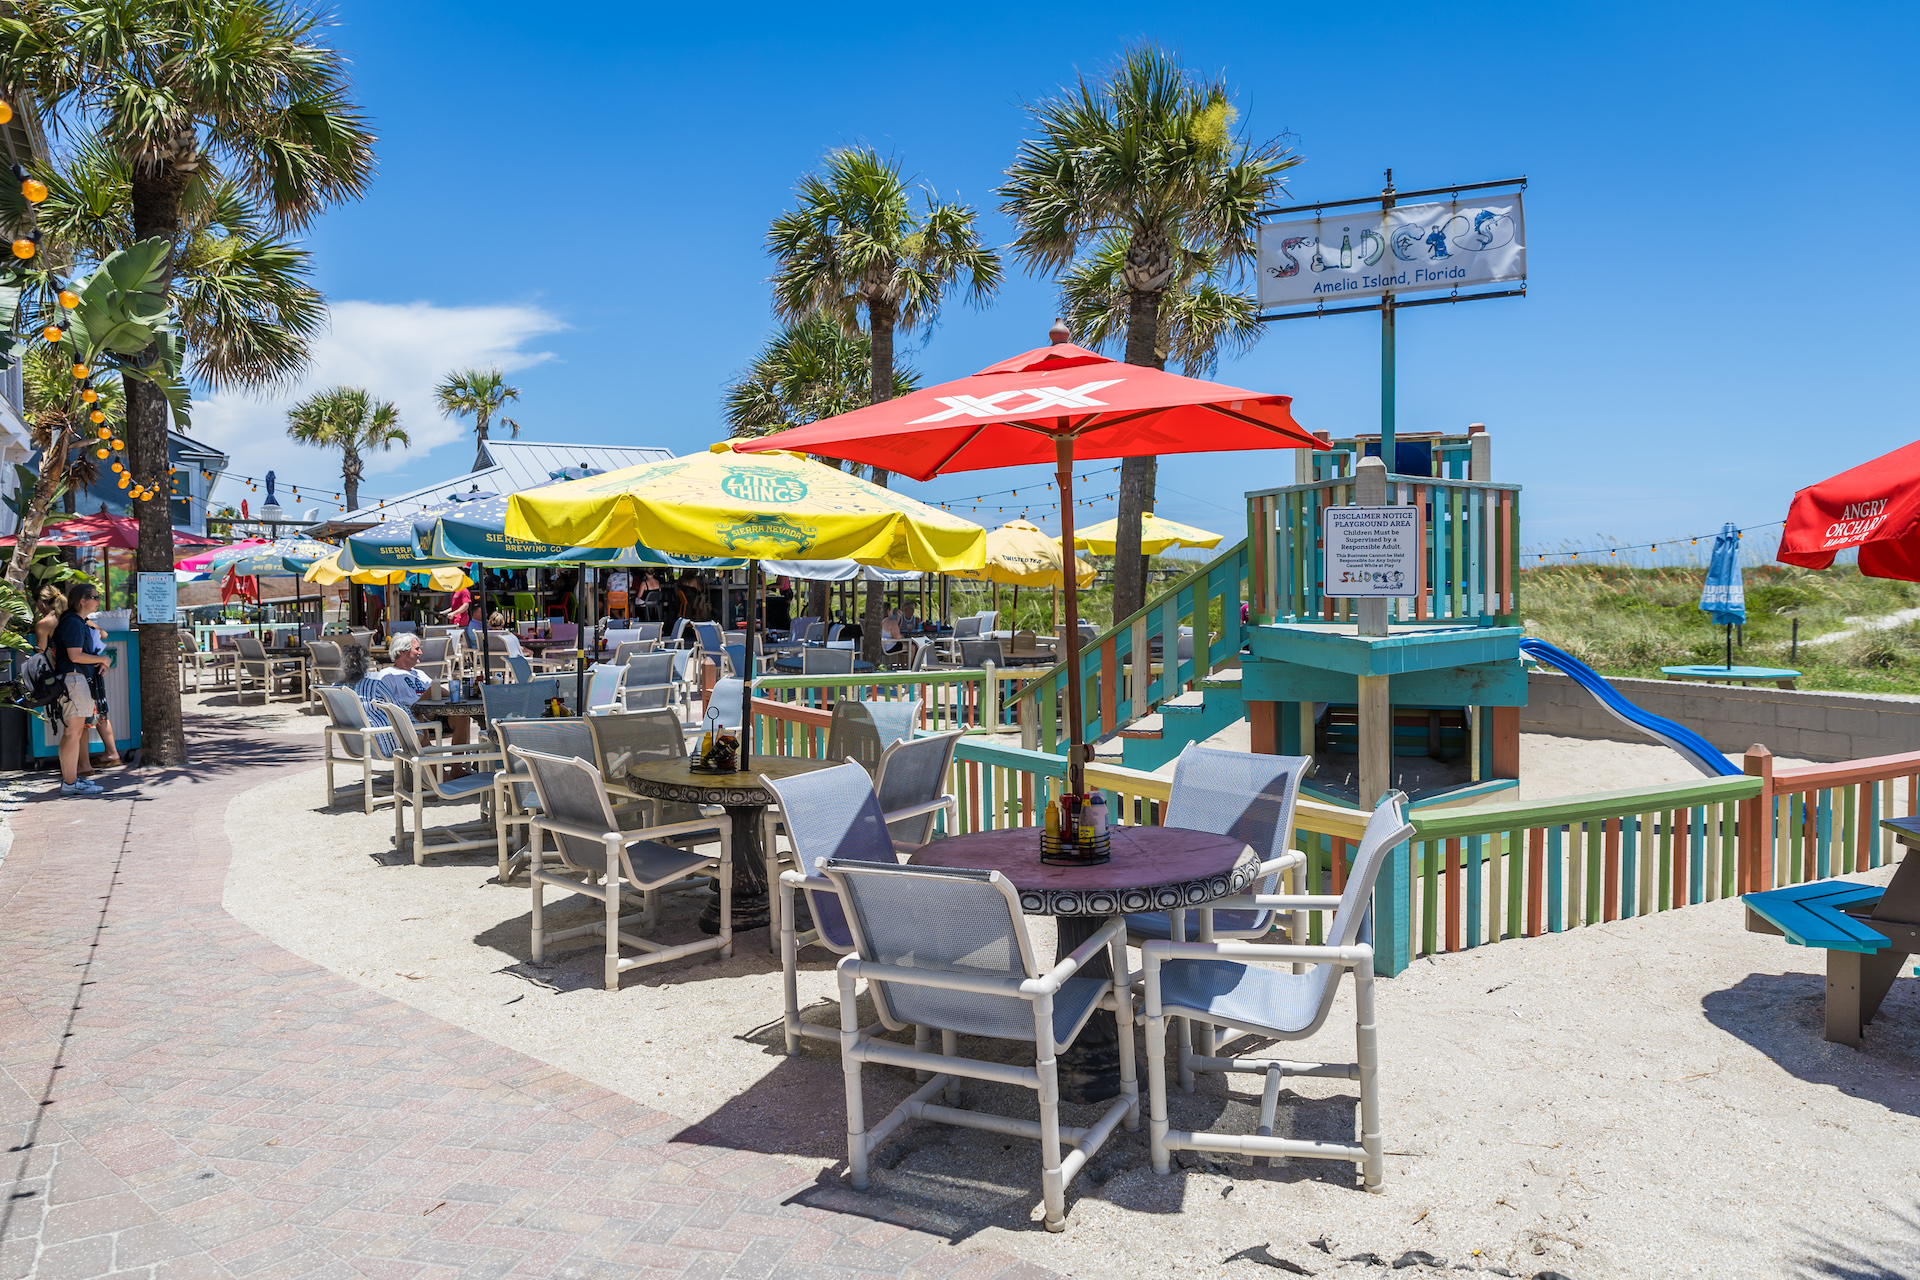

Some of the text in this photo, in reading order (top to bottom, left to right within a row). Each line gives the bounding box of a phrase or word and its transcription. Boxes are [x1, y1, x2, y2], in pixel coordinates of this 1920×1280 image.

[1313, 266, 1466, 294] Amelia Island, Florida
[904, 378, 1127, 425] XX
[727, 474, 803, 491] LITTLE
[727, 486, 802, 502] THINGS
[1841, 498, 1888, 521] ANGRY
[731, 525, 801, 540] SIERRA NEVADA
[1826, 514, 1888, 537] ORCHARD
[1345, 536, 1382, 544] Supervised
[1383, 536, 1392, 544] by
[505, 544, 547, 553] BREWING
[1002, 554, 1042, 565] TWISTED TEA
